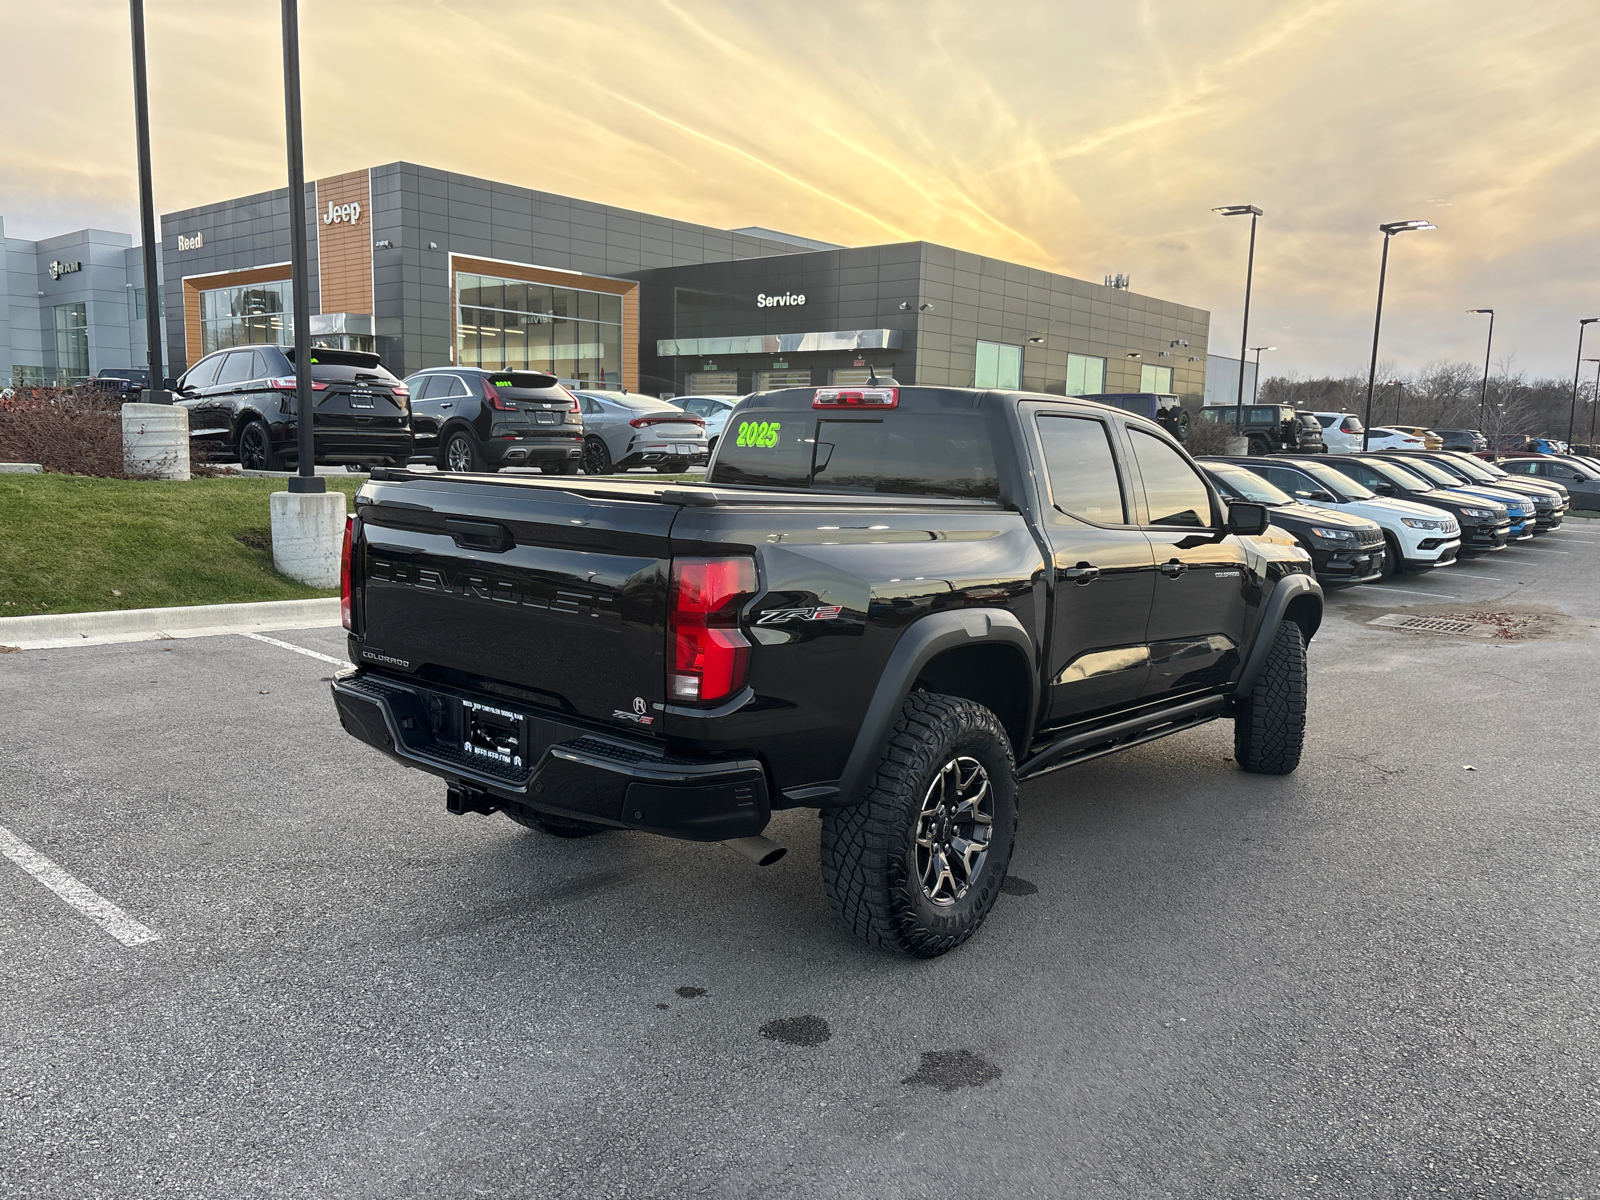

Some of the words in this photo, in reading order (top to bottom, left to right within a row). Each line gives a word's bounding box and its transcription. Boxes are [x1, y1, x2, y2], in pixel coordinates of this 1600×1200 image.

[323, 201, 361, 225] Jeep
[178, 232, 202, 251] Reed
[58, 262, 81, 275] RAM
[757, 291, 806, 308] Service
[736, 421, 781, 449] 2025
[369, 557, 616, 618] CHEVROLET
[756, 605, 843, 625] ZR2
[362, 650, 410, 668] COLORADO
[612, 709, 655, 725] ZR2
